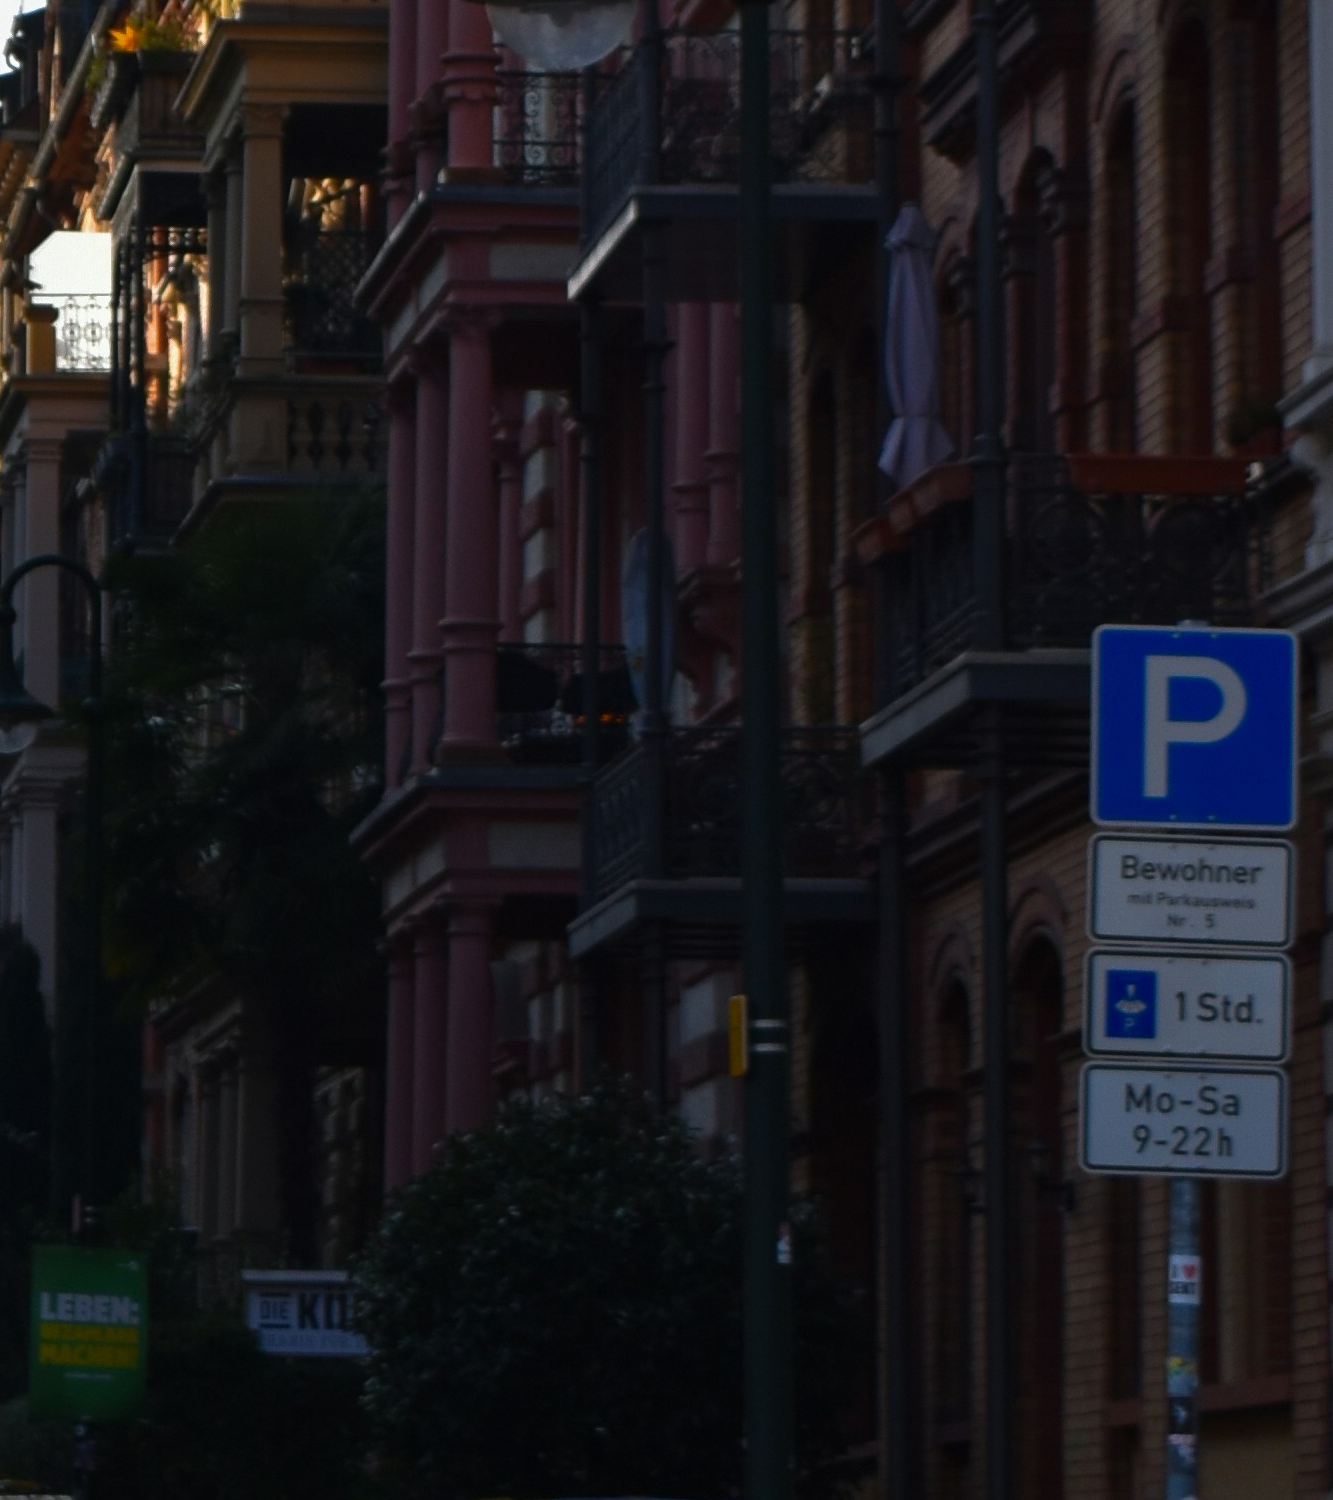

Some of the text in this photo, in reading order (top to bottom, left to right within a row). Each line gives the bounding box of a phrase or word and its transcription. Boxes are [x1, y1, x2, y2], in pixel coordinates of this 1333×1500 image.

[1141, 653, 1249, 800] P
[1120, 854, 1264, 884] Bewohner
[1127, 891, 1256, 909] mit Parkausweis
[1175, 991, 1263, 1024] 1 Std.
[1124, 1081, 1240, 1117] Mo-Sa
[39, 1290, 140, 1326] LEBEN:
[259, 1299, 289, 1320] DIE
